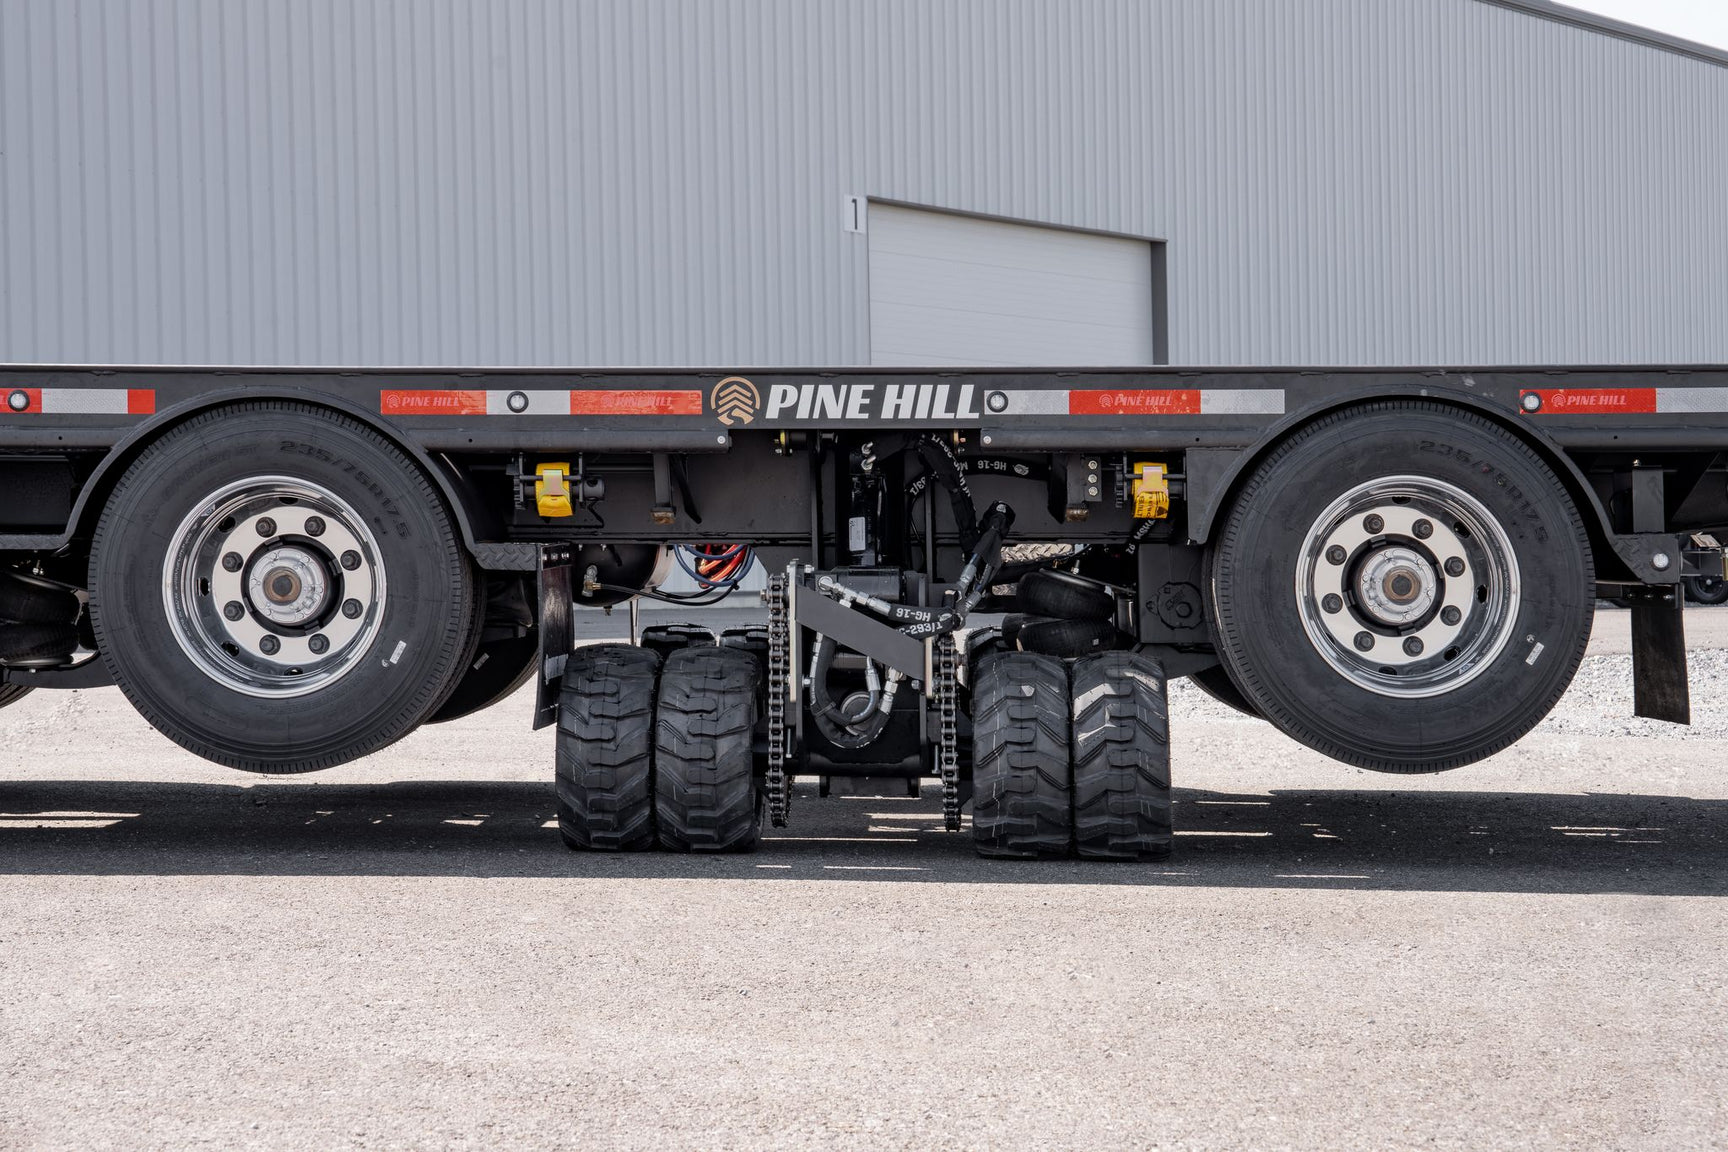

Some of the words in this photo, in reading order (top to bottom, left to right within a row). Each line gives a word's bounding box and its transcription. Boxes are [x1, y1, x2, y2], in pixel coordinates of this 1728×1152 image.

[851, 198, 858, 231] 1
[401, 396, 432, 407] PINE
[432, 396, 460, 407] HILL
[765, 384, 875, 419] PINE
[880, 384, 980, 419] HILL
[1114, 396, 1144, 406] PINE
[1145, 396, 1172, 406] HILL
[1566, 395, 1597, 406] PINE
[1598, 395, 1627, 405] HILL
[977, 460, 1007, 471] HG-16
[896, 607, 931, 622] HG-16
